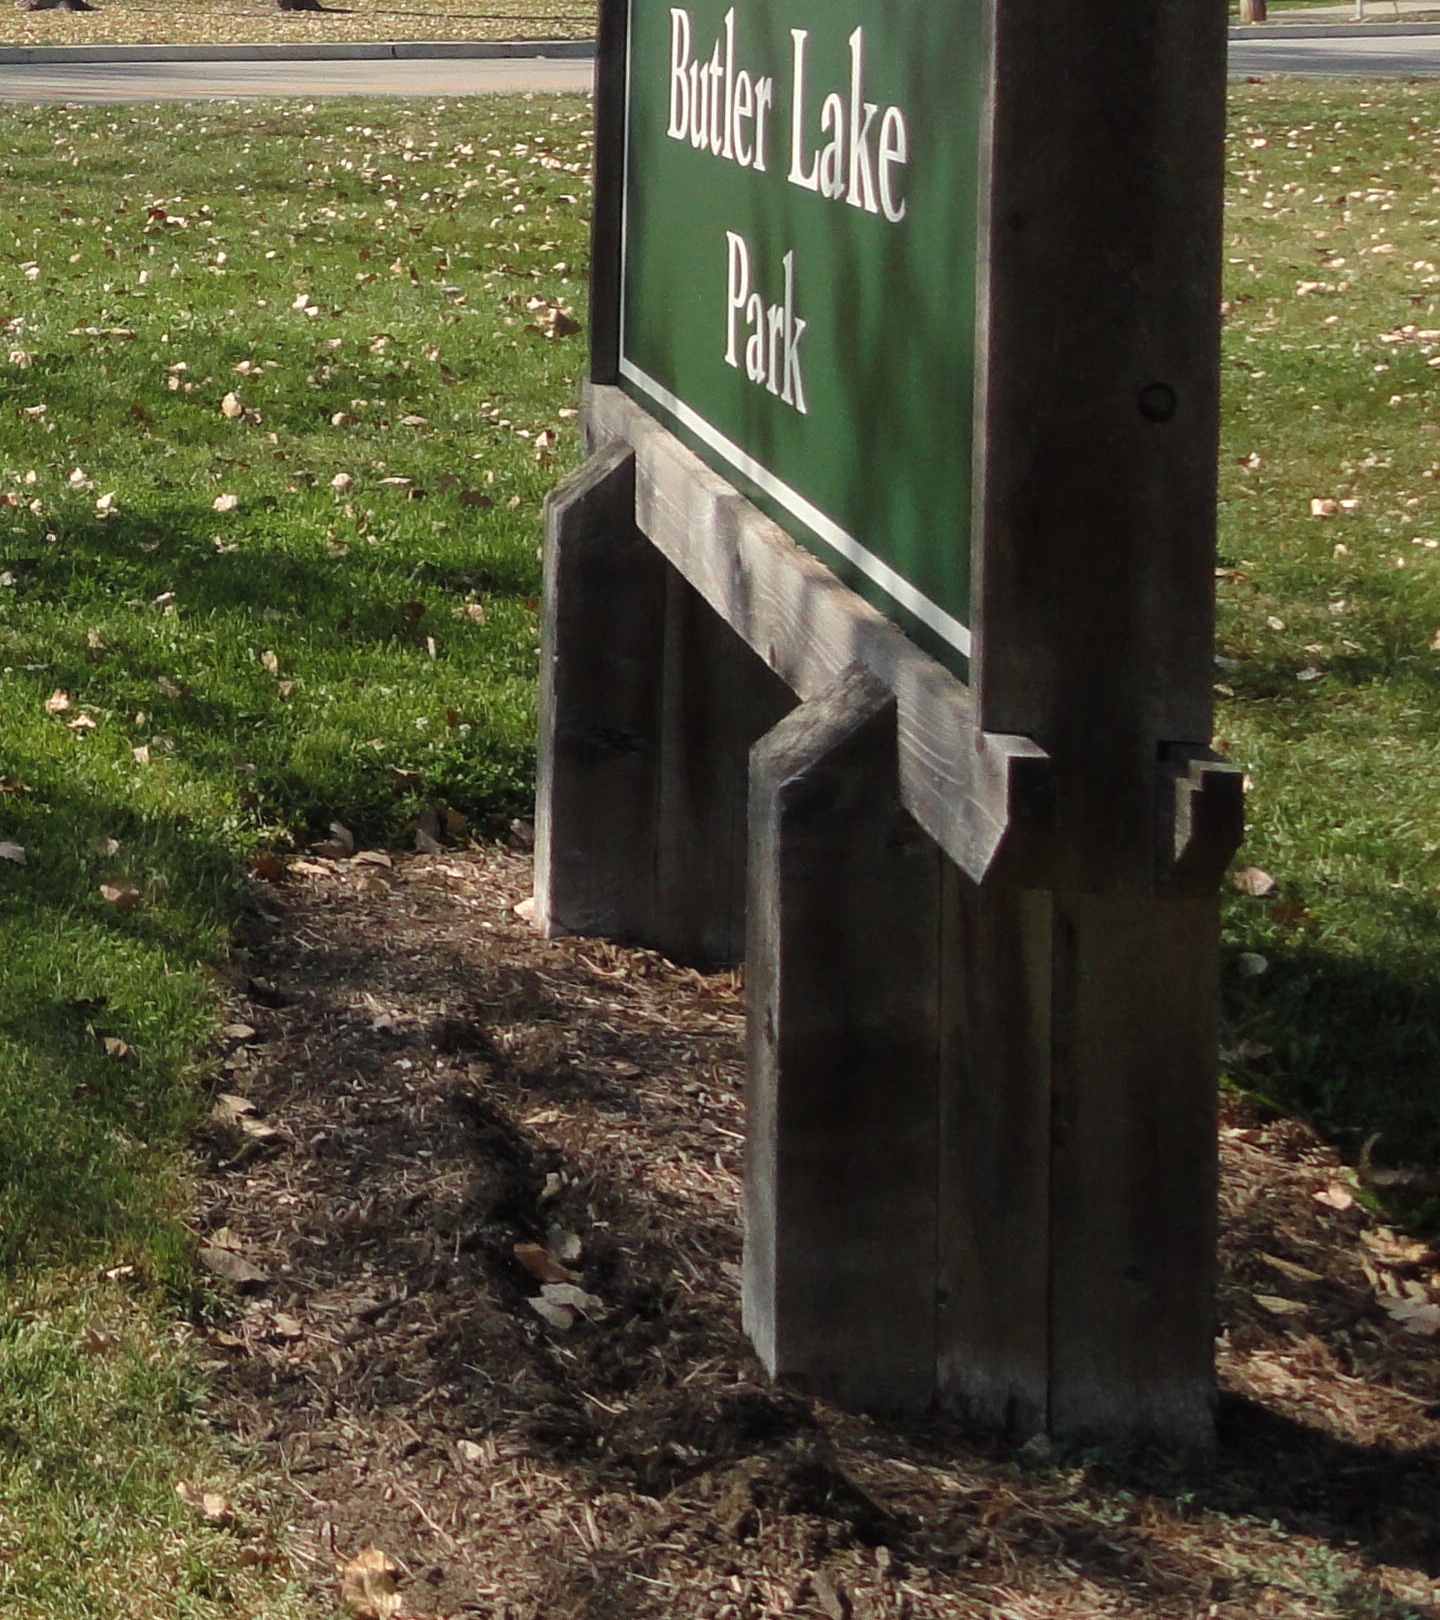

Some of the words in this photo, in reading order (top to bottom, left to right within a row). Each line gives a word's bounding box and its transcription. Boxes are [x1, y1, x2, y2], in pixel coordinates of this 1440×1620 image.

[667, 7, 773, 171] Butler
[788, 26, 907, 223] Lake
[724, 231, 807, 414] Park
